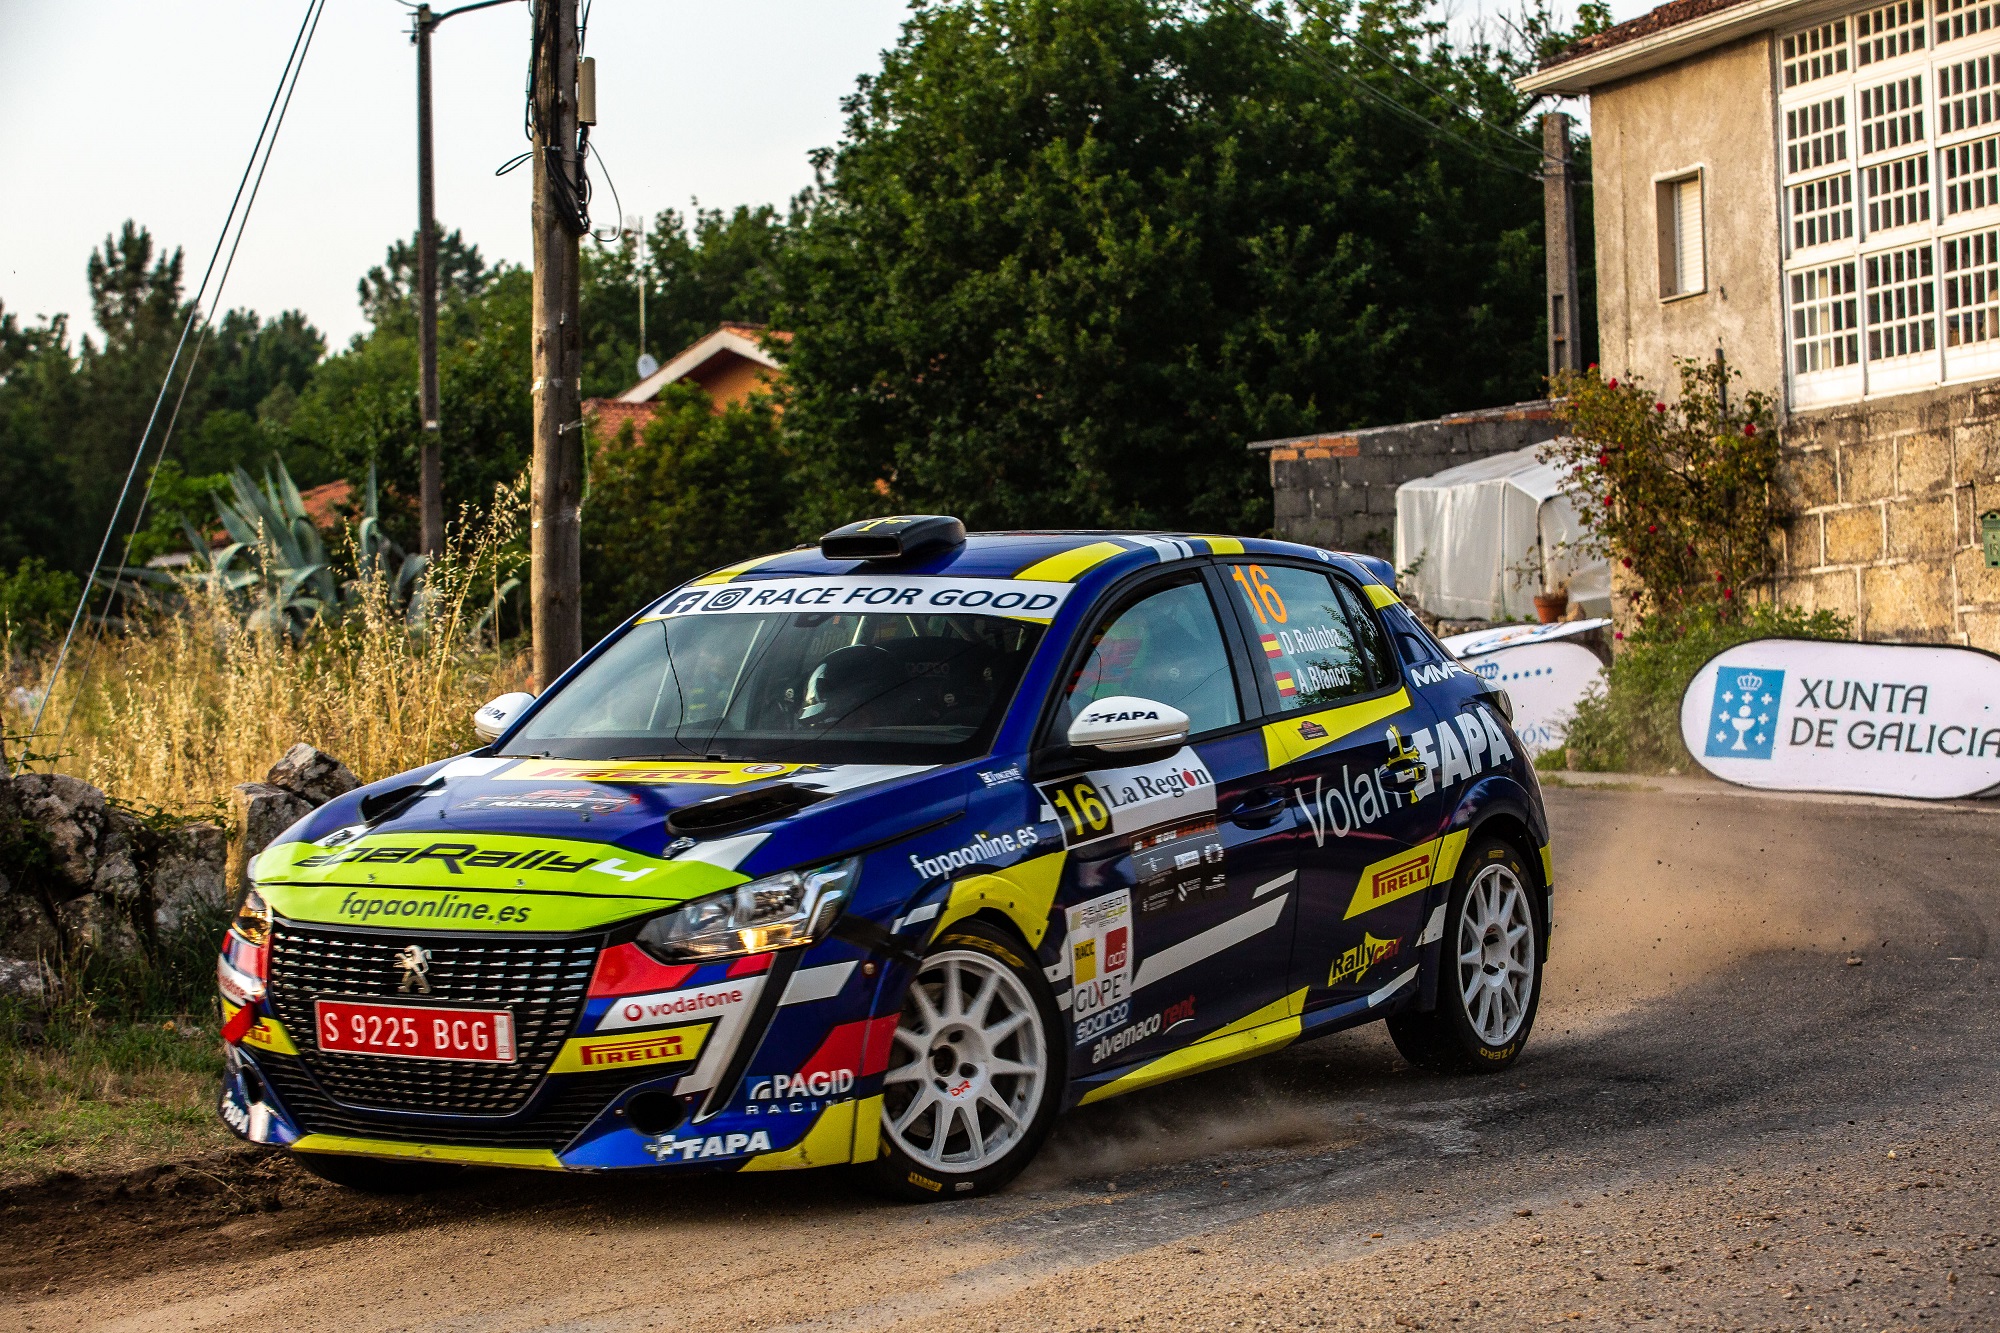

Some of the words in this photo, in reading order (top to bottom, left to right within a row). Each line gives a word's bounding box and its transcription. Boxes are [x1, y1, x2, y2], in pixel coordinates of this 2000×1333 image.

[747, 587, 843, 606] RACE
[842, 586, 924, 606] FOR
[928, 588, 1059, 611] GOOD
[1231, 564, 1288, 624] 16
[1279, 625, 1342, 656] D.Ruiloba
[1295, 665, 1351, 693] A.Blanco
[1796, 678, 1929, 715] XUNTA
[1101, 711, 1159, 723] FAPA
[1410, 705, 1515, 801] FAPA
[1789, 717, 1838, 748] DE
[1846, 720, 2000, 758] GALICIA
[529, 766, 732, 781] PIRELLI
[1053, 783, 1109, 836] 16
[1100, 783, 1141, 808] La
[909, 826, 1039, 881] fapaonline.es
[1372, 854, 1430, 899] PIRELLI
[337, 890, 532, 924] fapaonline.es
[647, 989, 744, 1018] vodafone
[323, 1012, 340, 1042] S
[351, 1014, 419, 1048] 9225
[433, 1019, 489, 1051] BCG
[1075, 1002, 1129, 1039] sparco
[1091, 1013, 1162, 1064] alvemaco
[1162, 994, 1196, 1031] rent
[579, 1035, 684, 1066] PIRELLI
[773, 1068, 855, 1099] PAGID
[745, 1097, 857, 1116] RACING
[674, 1130, 772, 1161] FAPA
